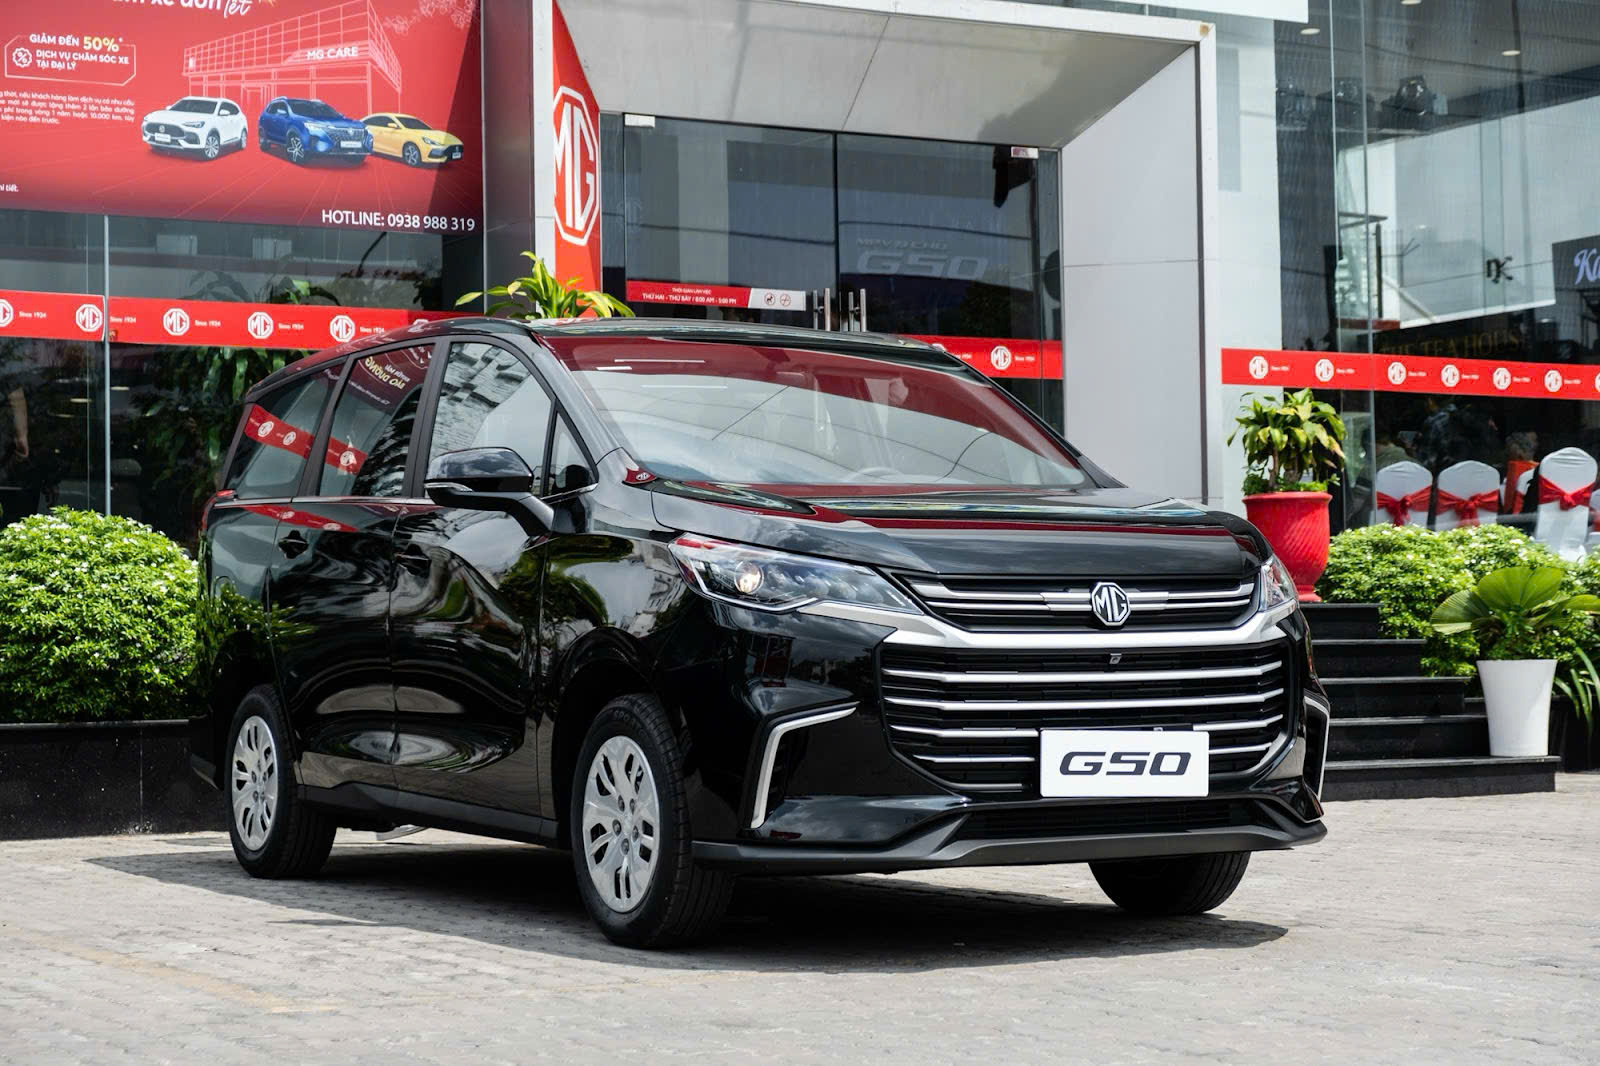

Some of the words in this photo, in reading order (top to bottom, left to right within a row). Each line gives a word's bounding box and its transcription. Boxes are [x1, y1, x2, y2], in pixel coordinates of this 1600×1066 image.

[29, 32, 56, 45] GIẢM
[58, 34, 80, 46] ĐẾN
[36, 49, 57, 59] DỊCH
[59, 51, 71, 61] VỤ
[99, 54, 117, 64] SÓC
[118, 56, 129, 64] XE
[327, 46, 358, 58] CARE
[36, 60, 49, 70] TẠI
[67, 61, 76, 70] LÝ
[553, 101, 596, 232] MG
[321, 209, 385, 226] HOTLINE:
[387, 213, 420, 228] 0938
[423, 215, 448, 230] 988
[451, 217, 475, 232] 319
[1093, 584, 1129, 624] MG
[1060, 752, 1192, 776] G50
